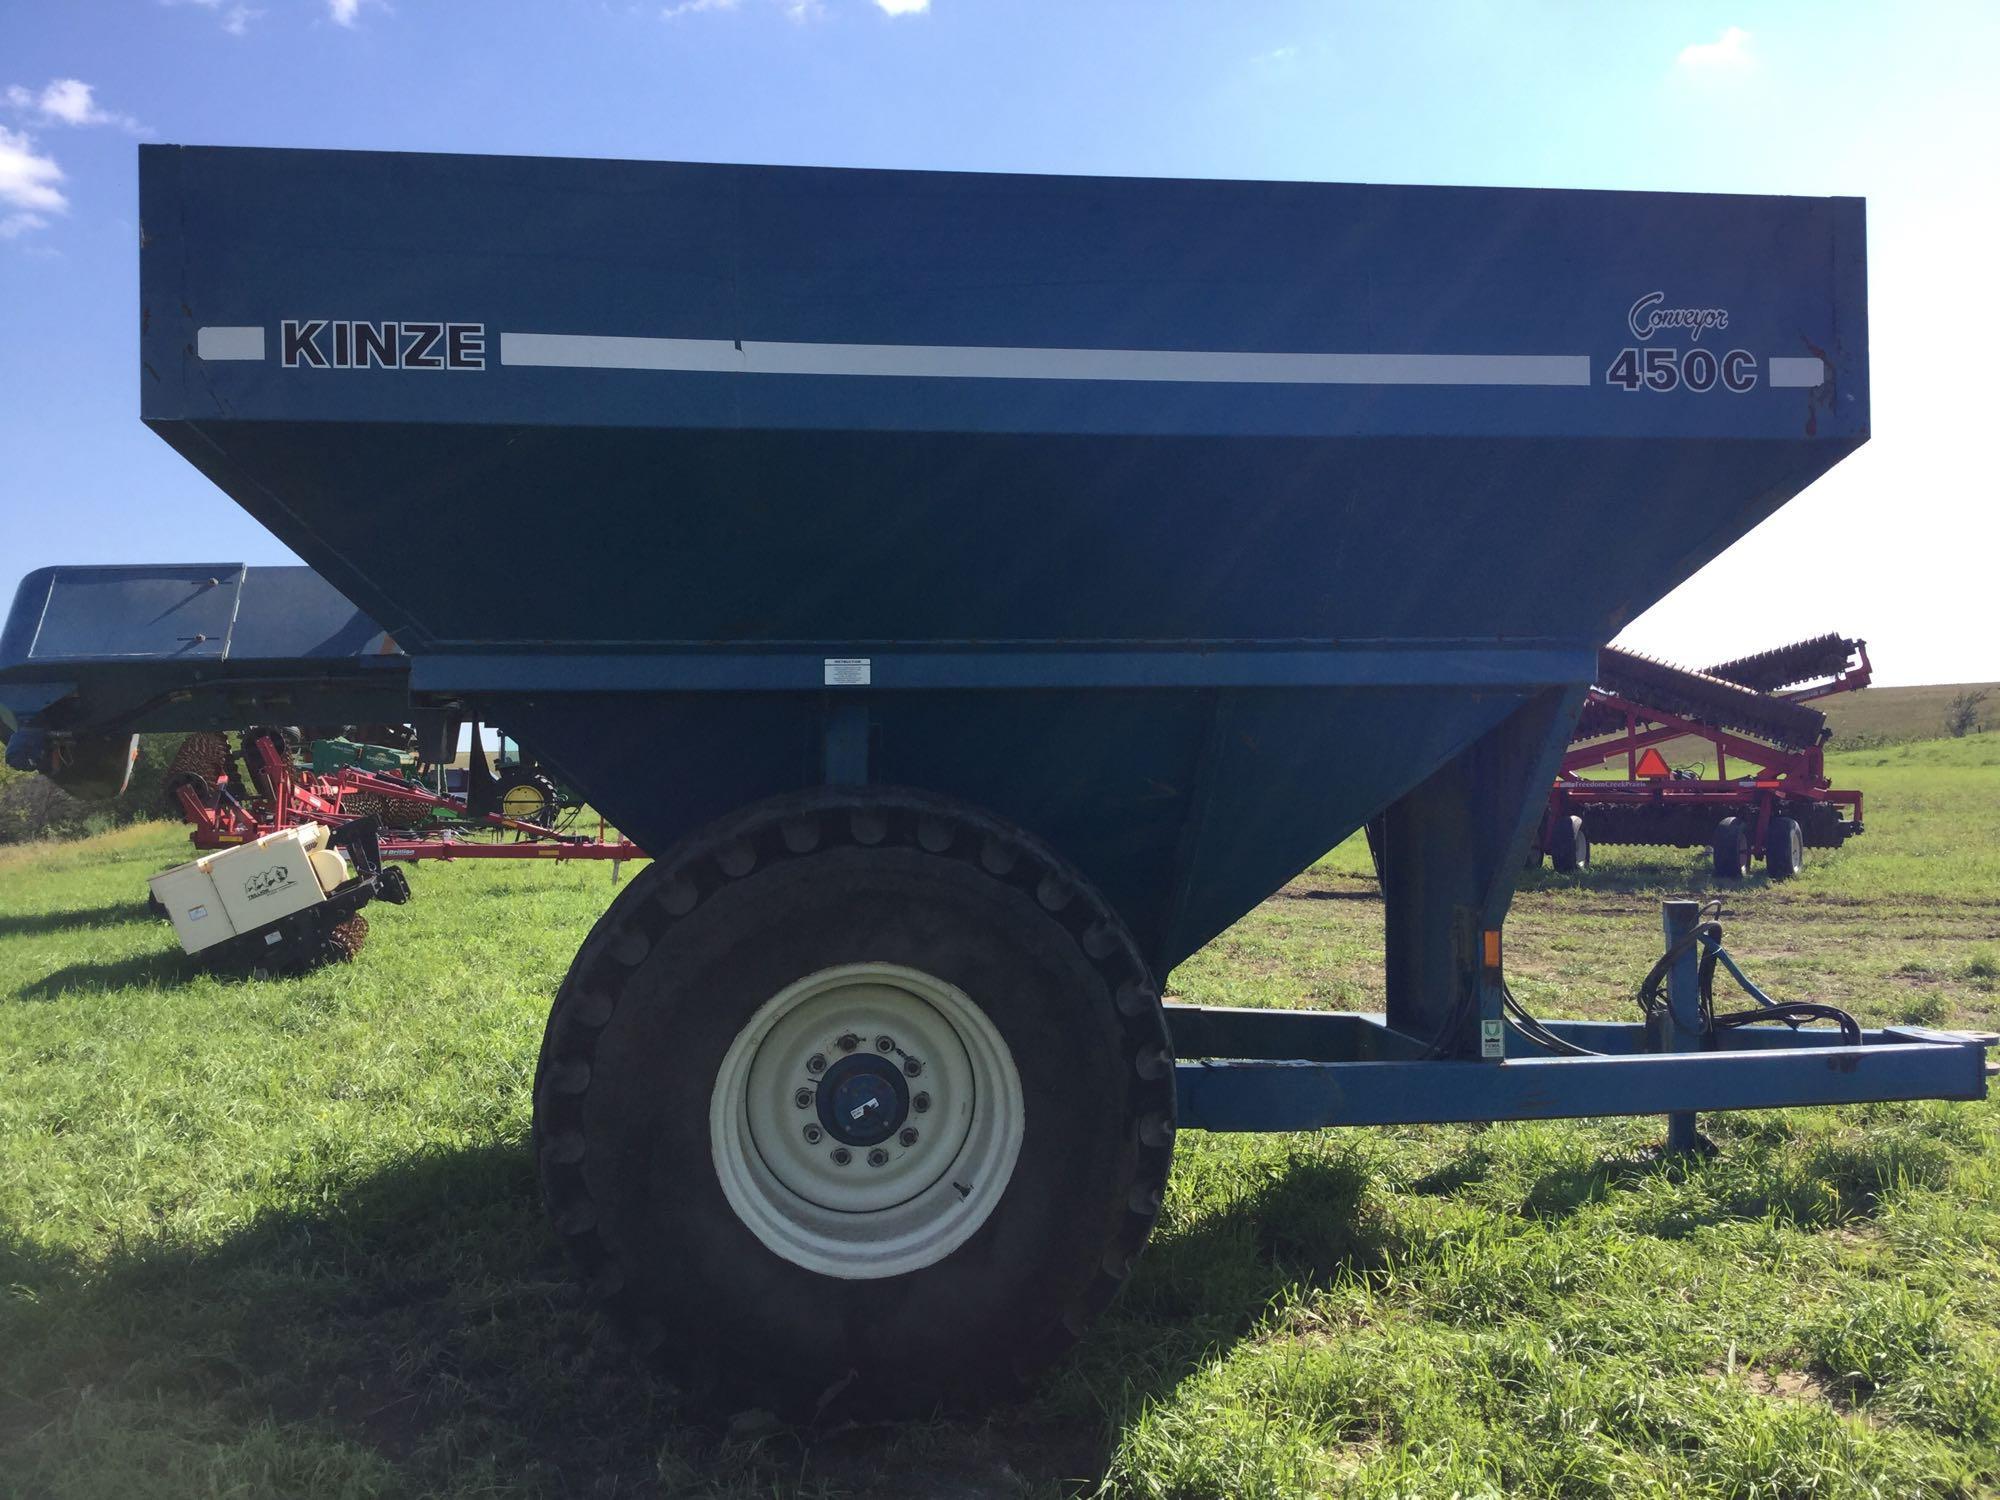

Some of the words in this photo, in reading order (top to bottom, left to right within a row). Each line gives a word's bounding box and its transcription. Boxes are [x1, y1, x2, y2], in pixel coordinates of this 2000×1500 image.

[1628, 291, 1729, 341] Conveyor
[281, 319, 486, 371] KINZE
[1606, 347, 1758, 394] 450C
